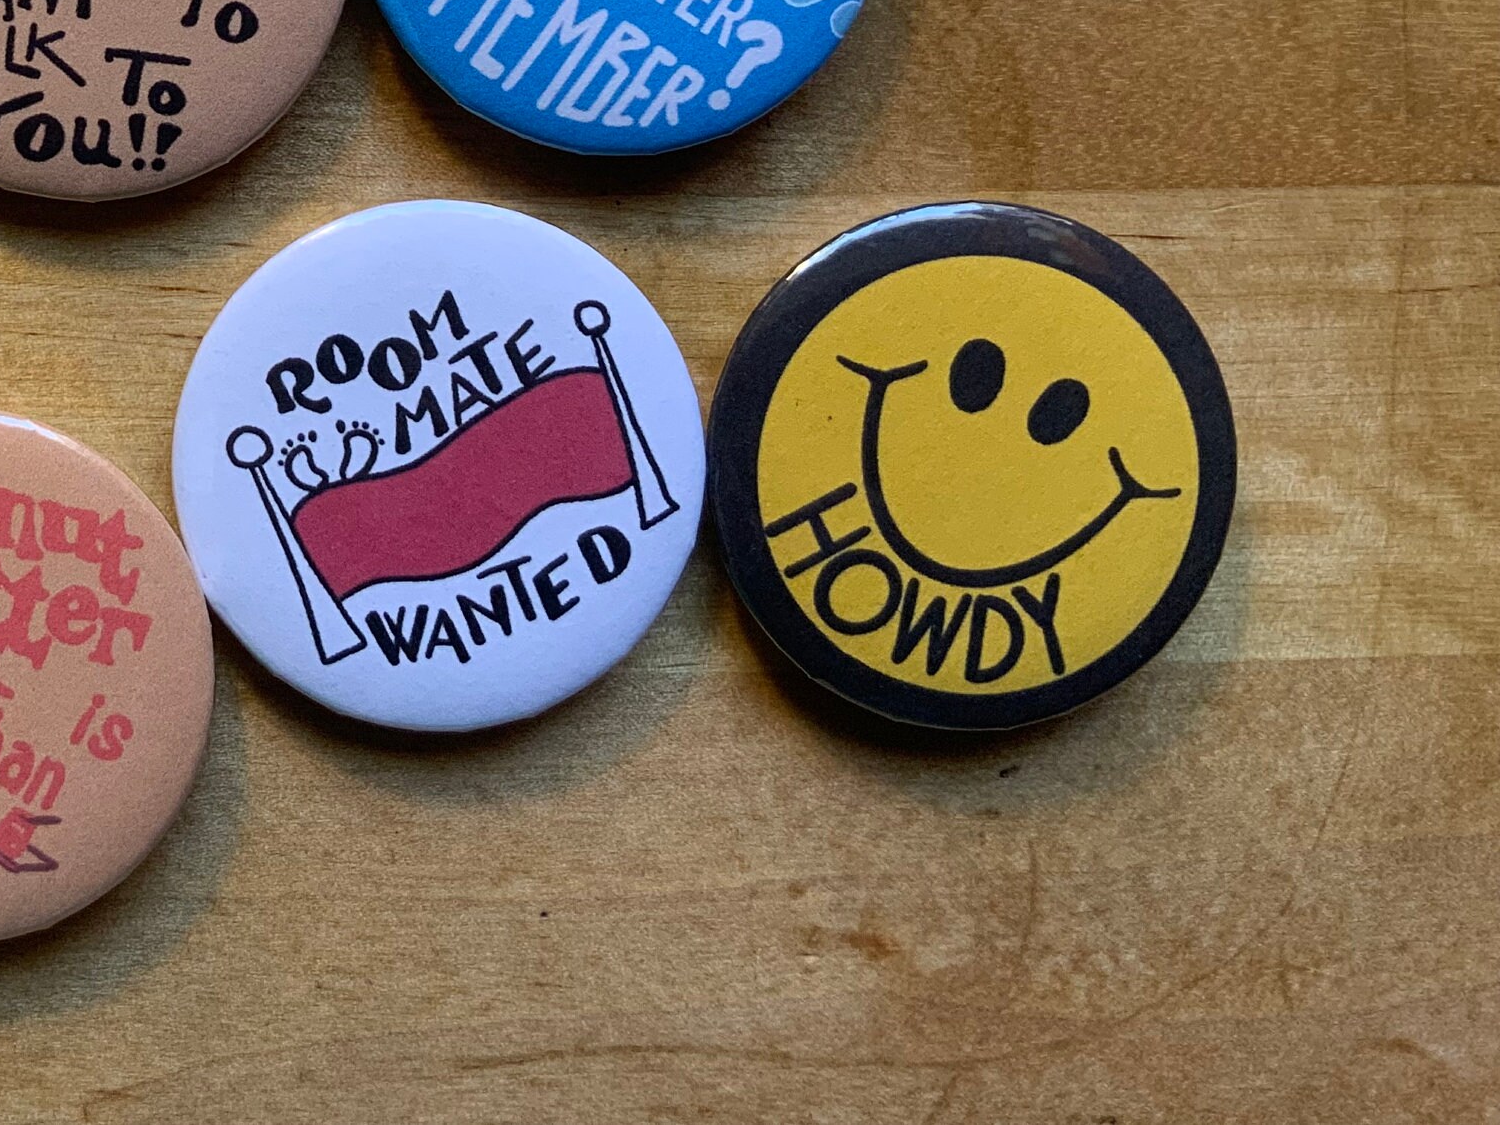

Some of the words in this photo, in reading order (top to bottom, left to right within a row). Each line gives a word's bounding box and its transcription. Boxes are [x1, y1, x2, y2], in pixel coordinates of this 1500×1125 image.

[265, 289, 470, 415] ROOM
[393, 318, 557, 455] MATE
[364, 524, 633, 667] WANTED
[764, 482, 1067, 684] HOWDY
[68, 693, 135, 762] is
